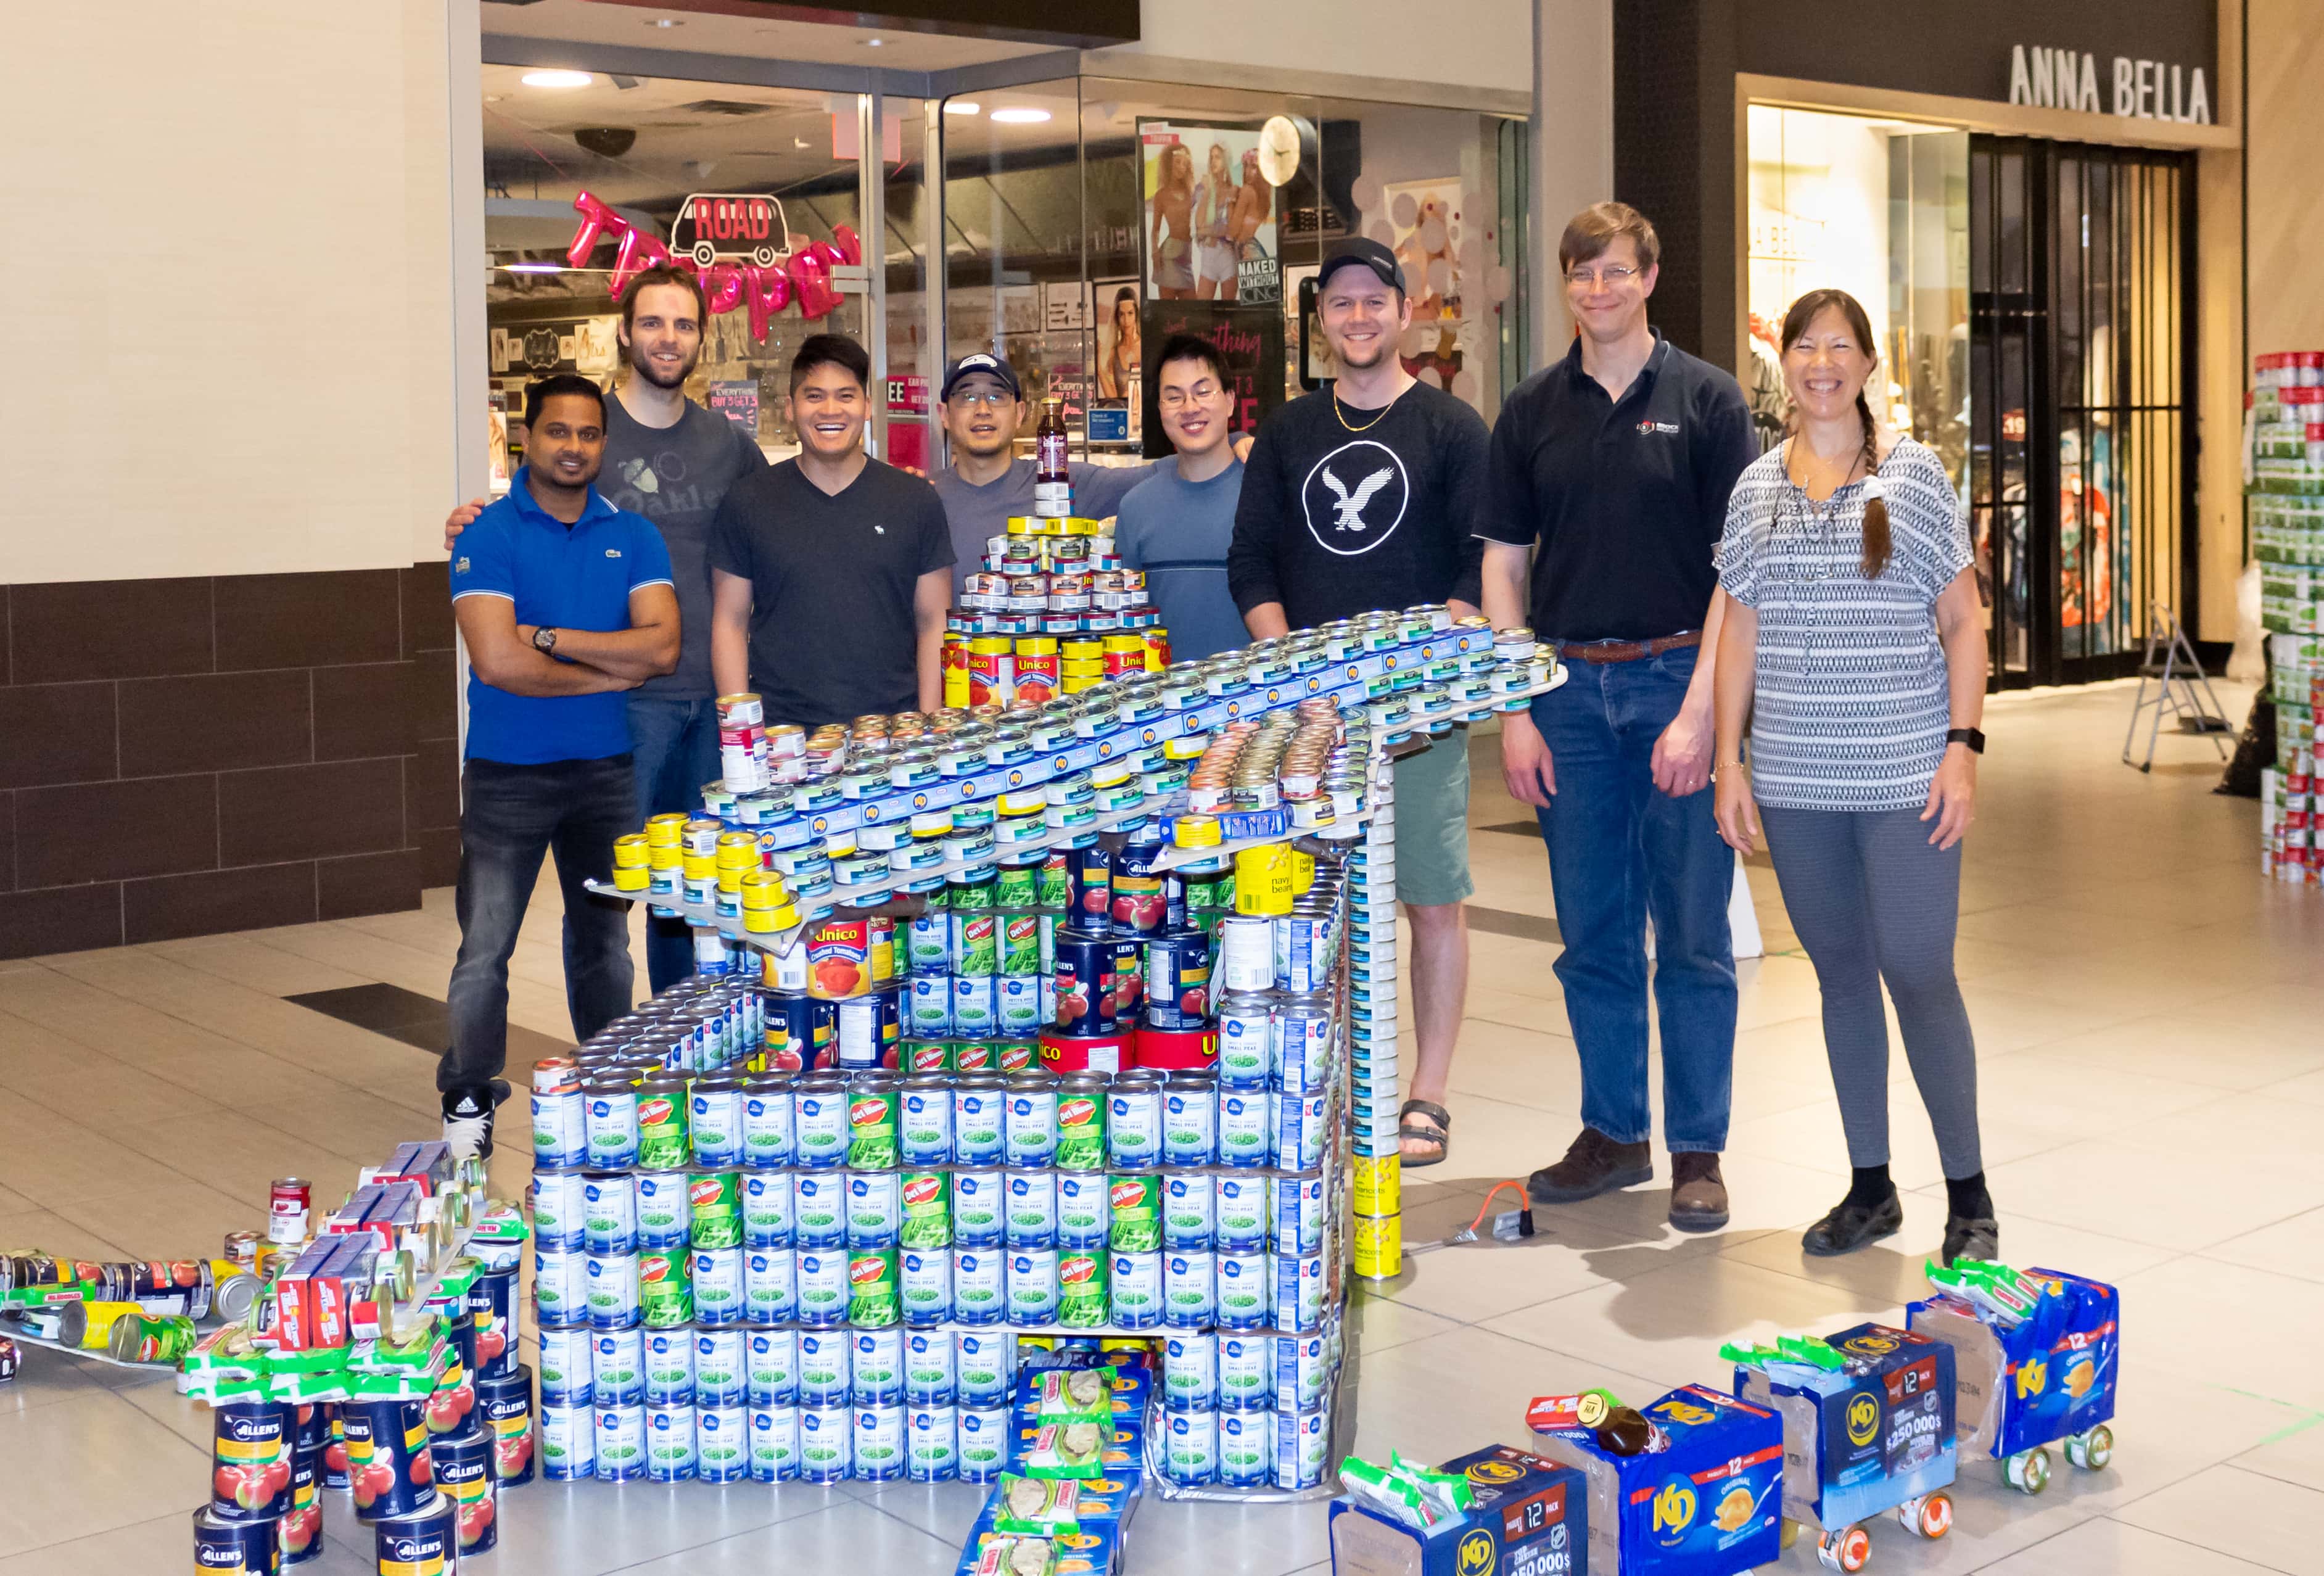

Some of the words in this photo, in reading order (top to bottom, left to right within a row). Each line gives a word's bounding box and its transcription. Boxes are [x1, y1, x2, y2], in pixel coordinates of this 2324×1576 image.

[2009, 44, 2101, 113] ANNA
[2113, 56, 2210, 125] BELLA
[694, 198, 770, 240] ROAD
[1238, 259, 1276, 277] NAKED
[1238, 273, 1279, 289] WITHOUT
[970, 660, 988, 669] nico
[1018, 660, 1050, 670] Unico
[1272, 877, 1289, 885] navy
[968, 928, 981, 939] Del
[1010, 927, 1022, 939] Del
[811, 947, 833, 962] Crushed
[833, 946, 862, 961] Tomatoes
[1117, 944, 1134, 953] LEN'S
[1057, 962, 1074, 971] LLEN'S
[765, 1015, 786, 1026] LLEN'S
[916, 1057, 927, 1067] Del
[959, 1057, 971, 1068] Del
[1002, 1057, 1013, 1068] Del
[852, 1112, 865, 1122] Del
[1059, 1112, 1072, 1122] Del
[905, 1190, 918, 1202] Del
[1111, 1192, 1122, 1203] Del
[1060, 1266, 1073, 1279] Del
[468, 1298, 491, 1307] LEN'S
[2069, 1332, 2087, 1350] 12
[1905, 1371, 1918, 1394] 12
[492, 1400, 525, 1415] ALLEN'S
[1850, 1400, 1876, 1428] KD
[236, 1422, 280, 1436] ALLEN'S
[1913, 1414, 1942, 1434] 000$
[445, 1463, 484, 1479] ALLEN'S
[1728, 1457, 1742, 1476] 12
[1721, 1477, 1751, 1496] ORIGINAL
[1527, 1502, 1542, 1529] 12
[1546, 1500, 1559, 1515] PACK
[1653, 1483, 1696, 1535] KD
[399, 1540, 442, 1556] ALLEN'S
[1461, 1537, 1491, 1569] KD
[202, 1549, 242, 1562] ALLEN'S
[1537, 1553, 1571, 1575] 000$
